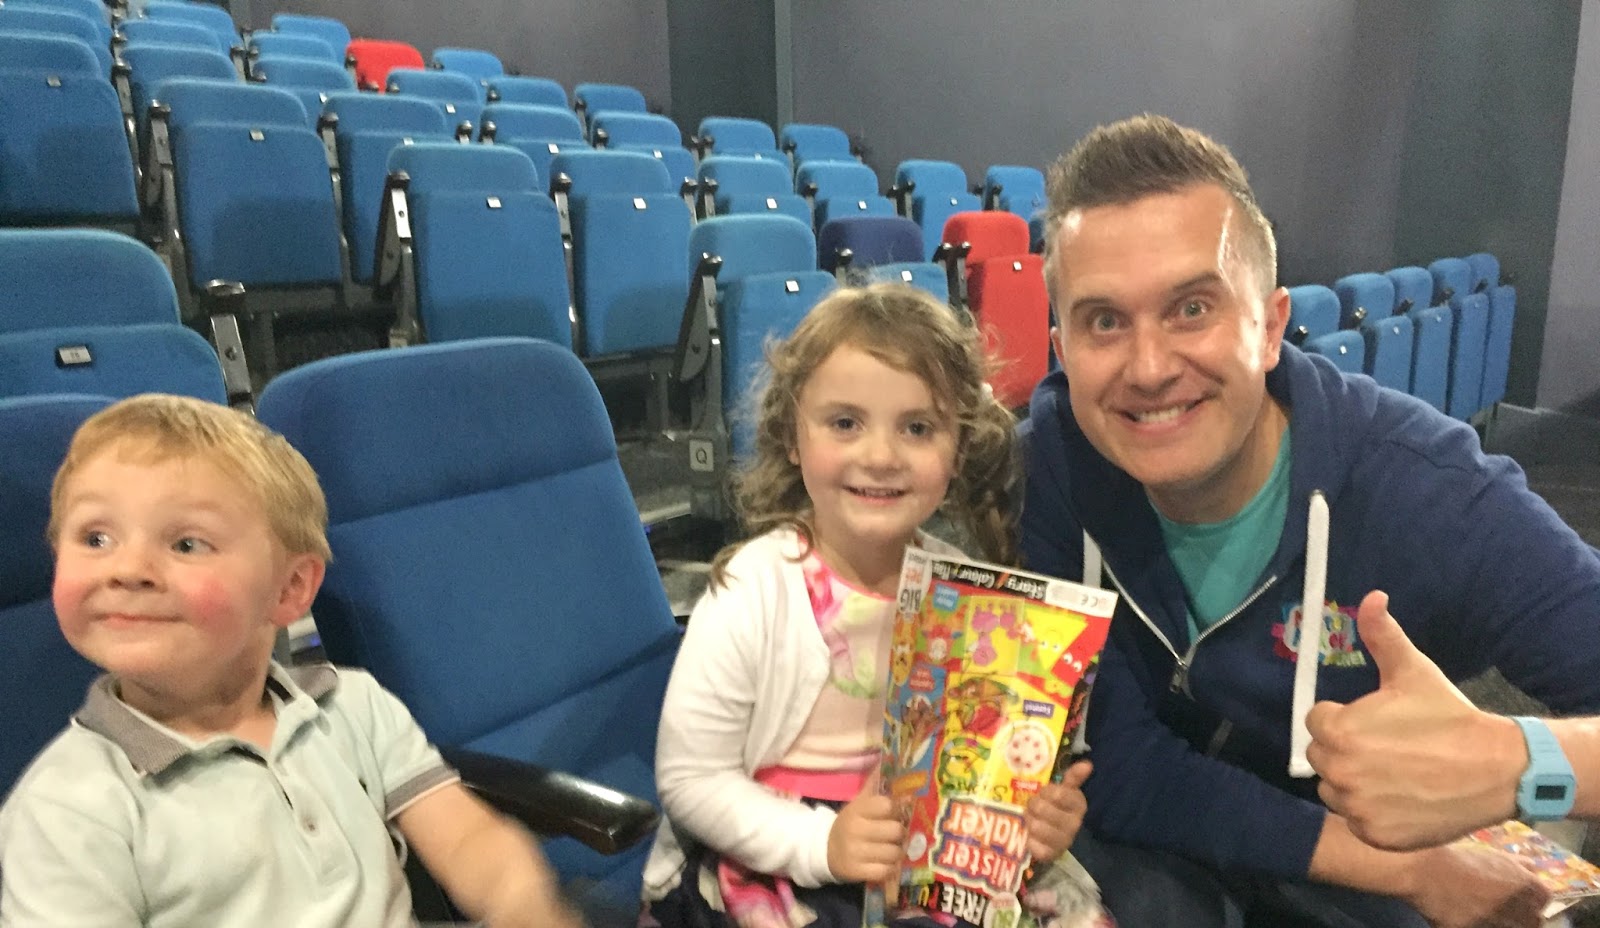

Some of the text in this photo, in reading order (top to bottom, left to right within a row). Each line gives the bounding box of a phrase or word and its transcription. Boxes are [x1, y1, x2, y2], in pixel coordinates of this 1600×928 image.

[695, 448, 707, 465] Q
[900, 588, 921, 613] BIG
[1006, 577, 1046, 599] Story
[946, 803, 1028, 858] Maker
[942, 840, 1016, 891] Mister
[941, 883, 985, 925] FREE
